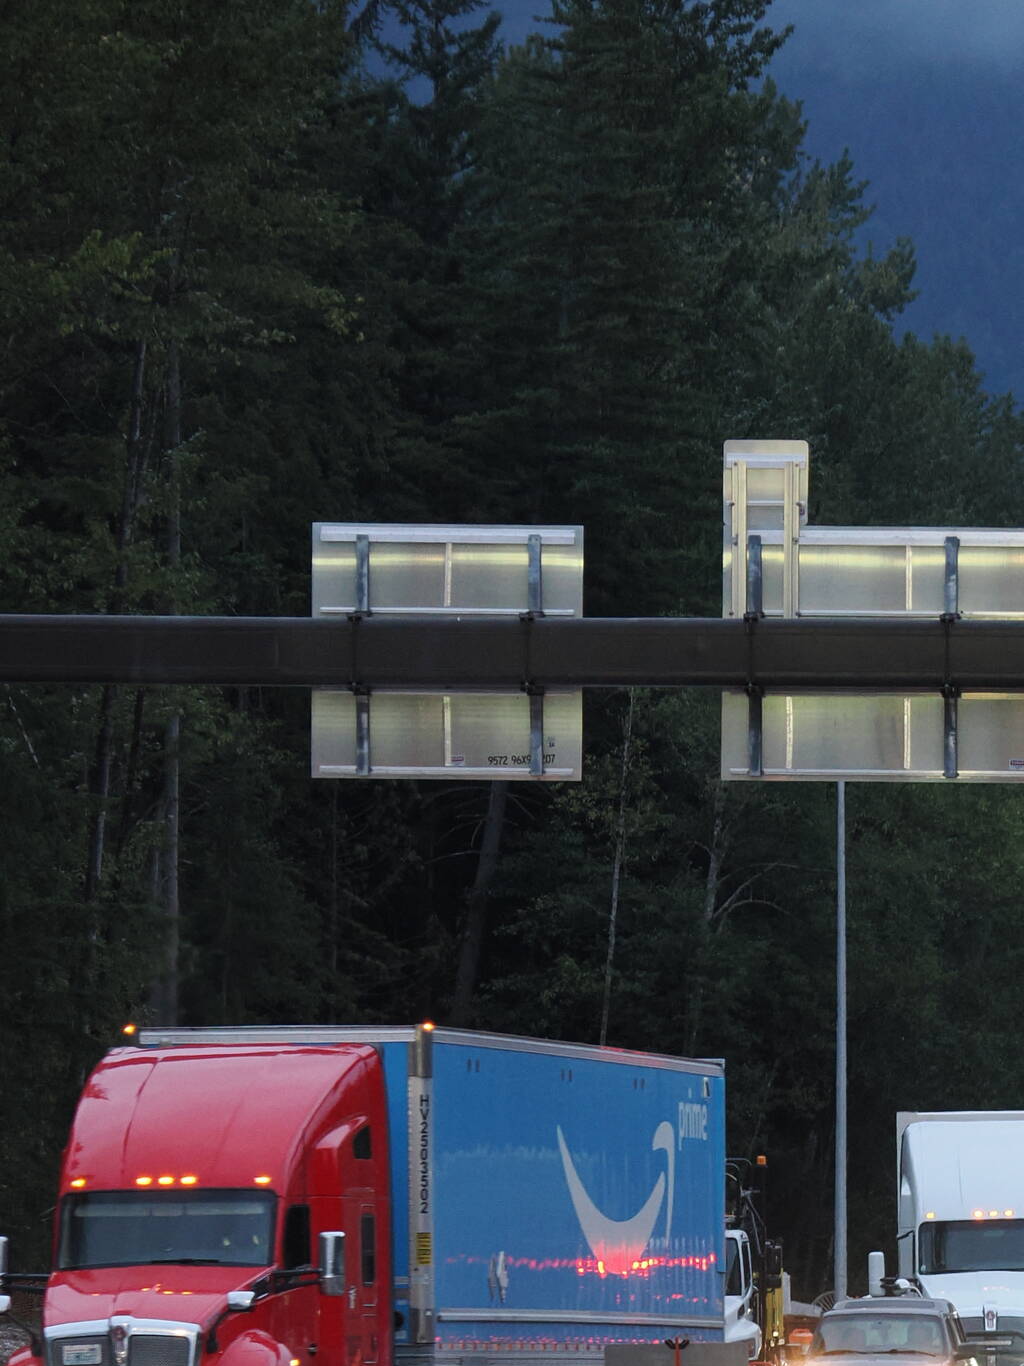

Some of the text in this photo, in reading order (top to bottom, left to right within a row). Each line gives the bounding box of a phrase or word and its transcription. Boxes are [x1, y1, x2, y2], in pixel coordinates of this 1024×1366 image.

[488, 756, 508, 765] 9572
[511, 754, 532, 765] 96X9
[679, 1088, 707, 1151] prime
[419, 1094, 430, 1214] HV2503502
